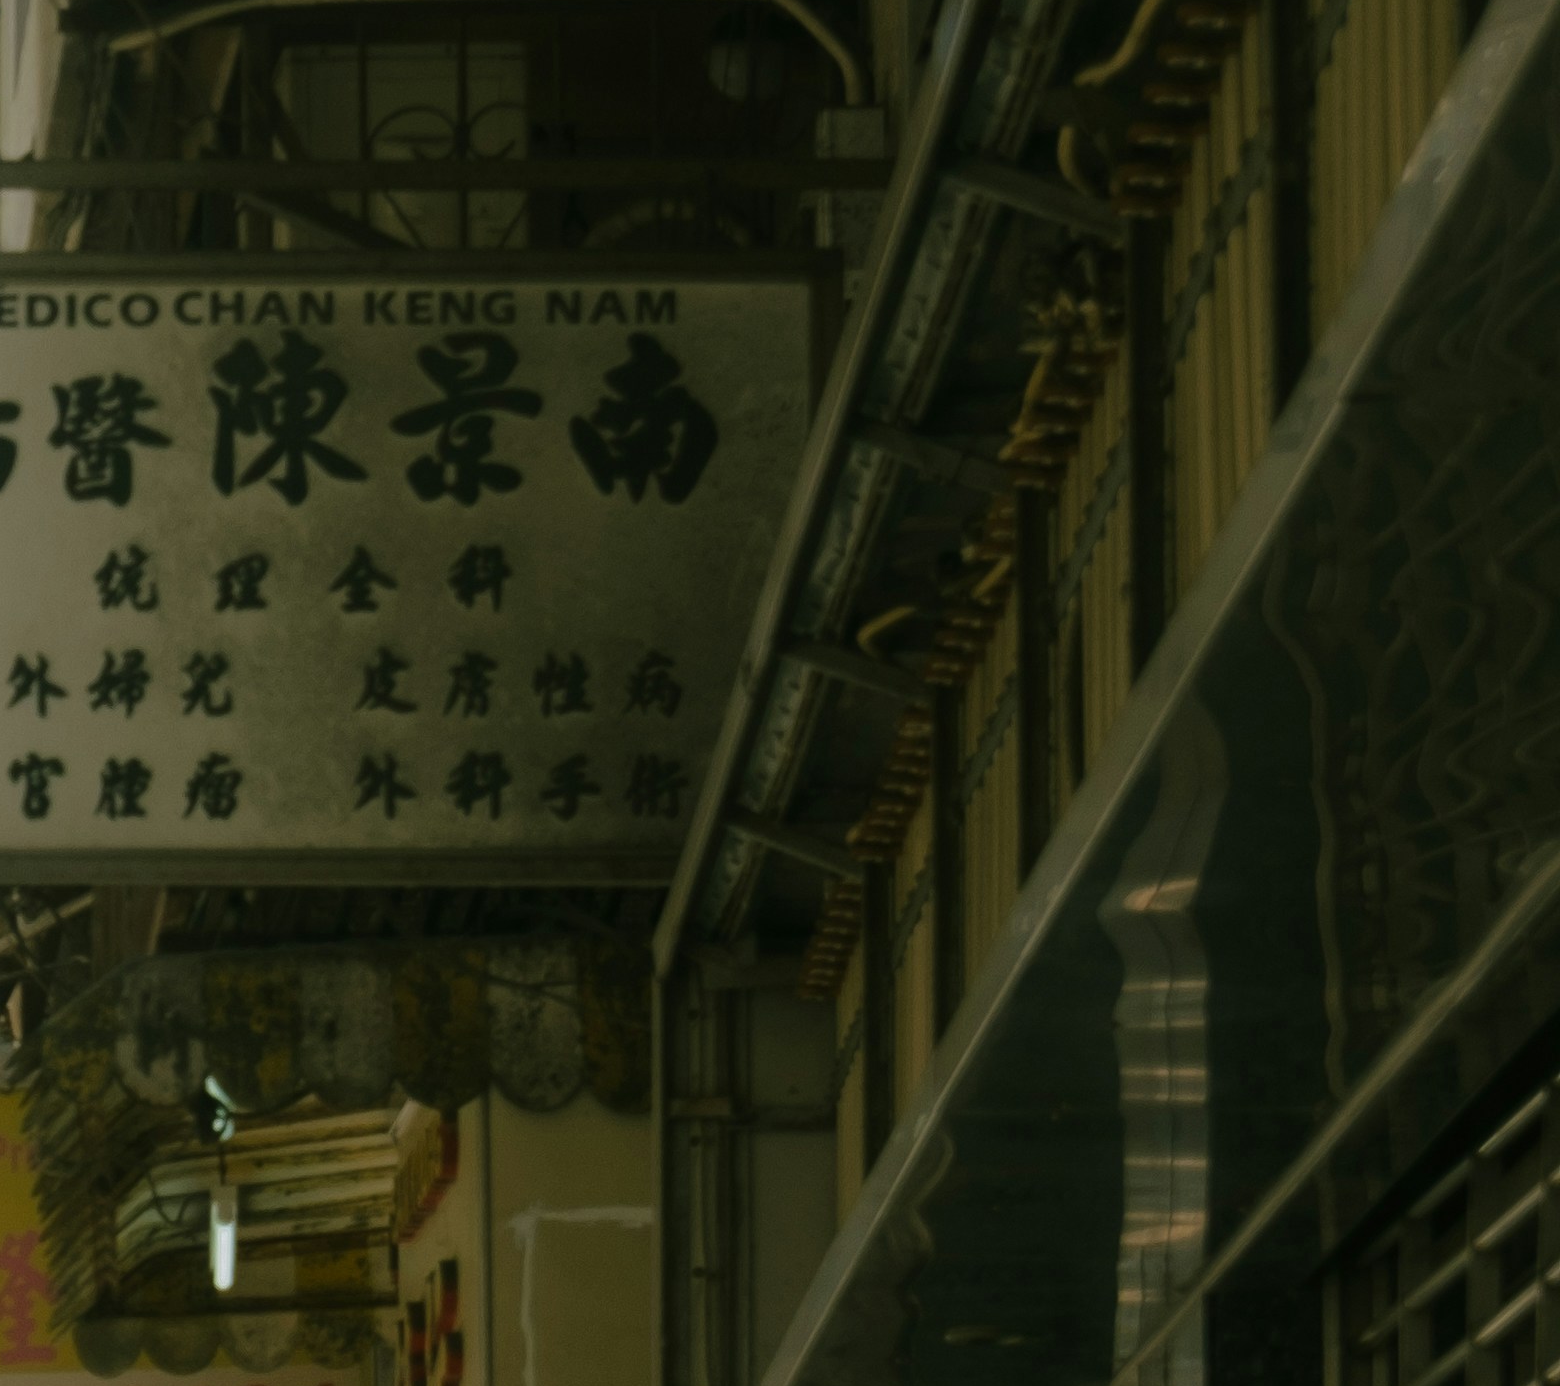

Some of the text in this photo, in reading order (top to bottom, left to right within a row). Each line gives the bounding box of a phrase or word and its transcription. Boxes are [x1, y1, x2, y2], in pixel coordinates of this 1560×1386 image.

[174, 289, 337, 327] CHAN
[363, 289, 518, 327] KENG
[544, 289, 678, 326] NAM
[354, 752, 688, 823] 外科手術
